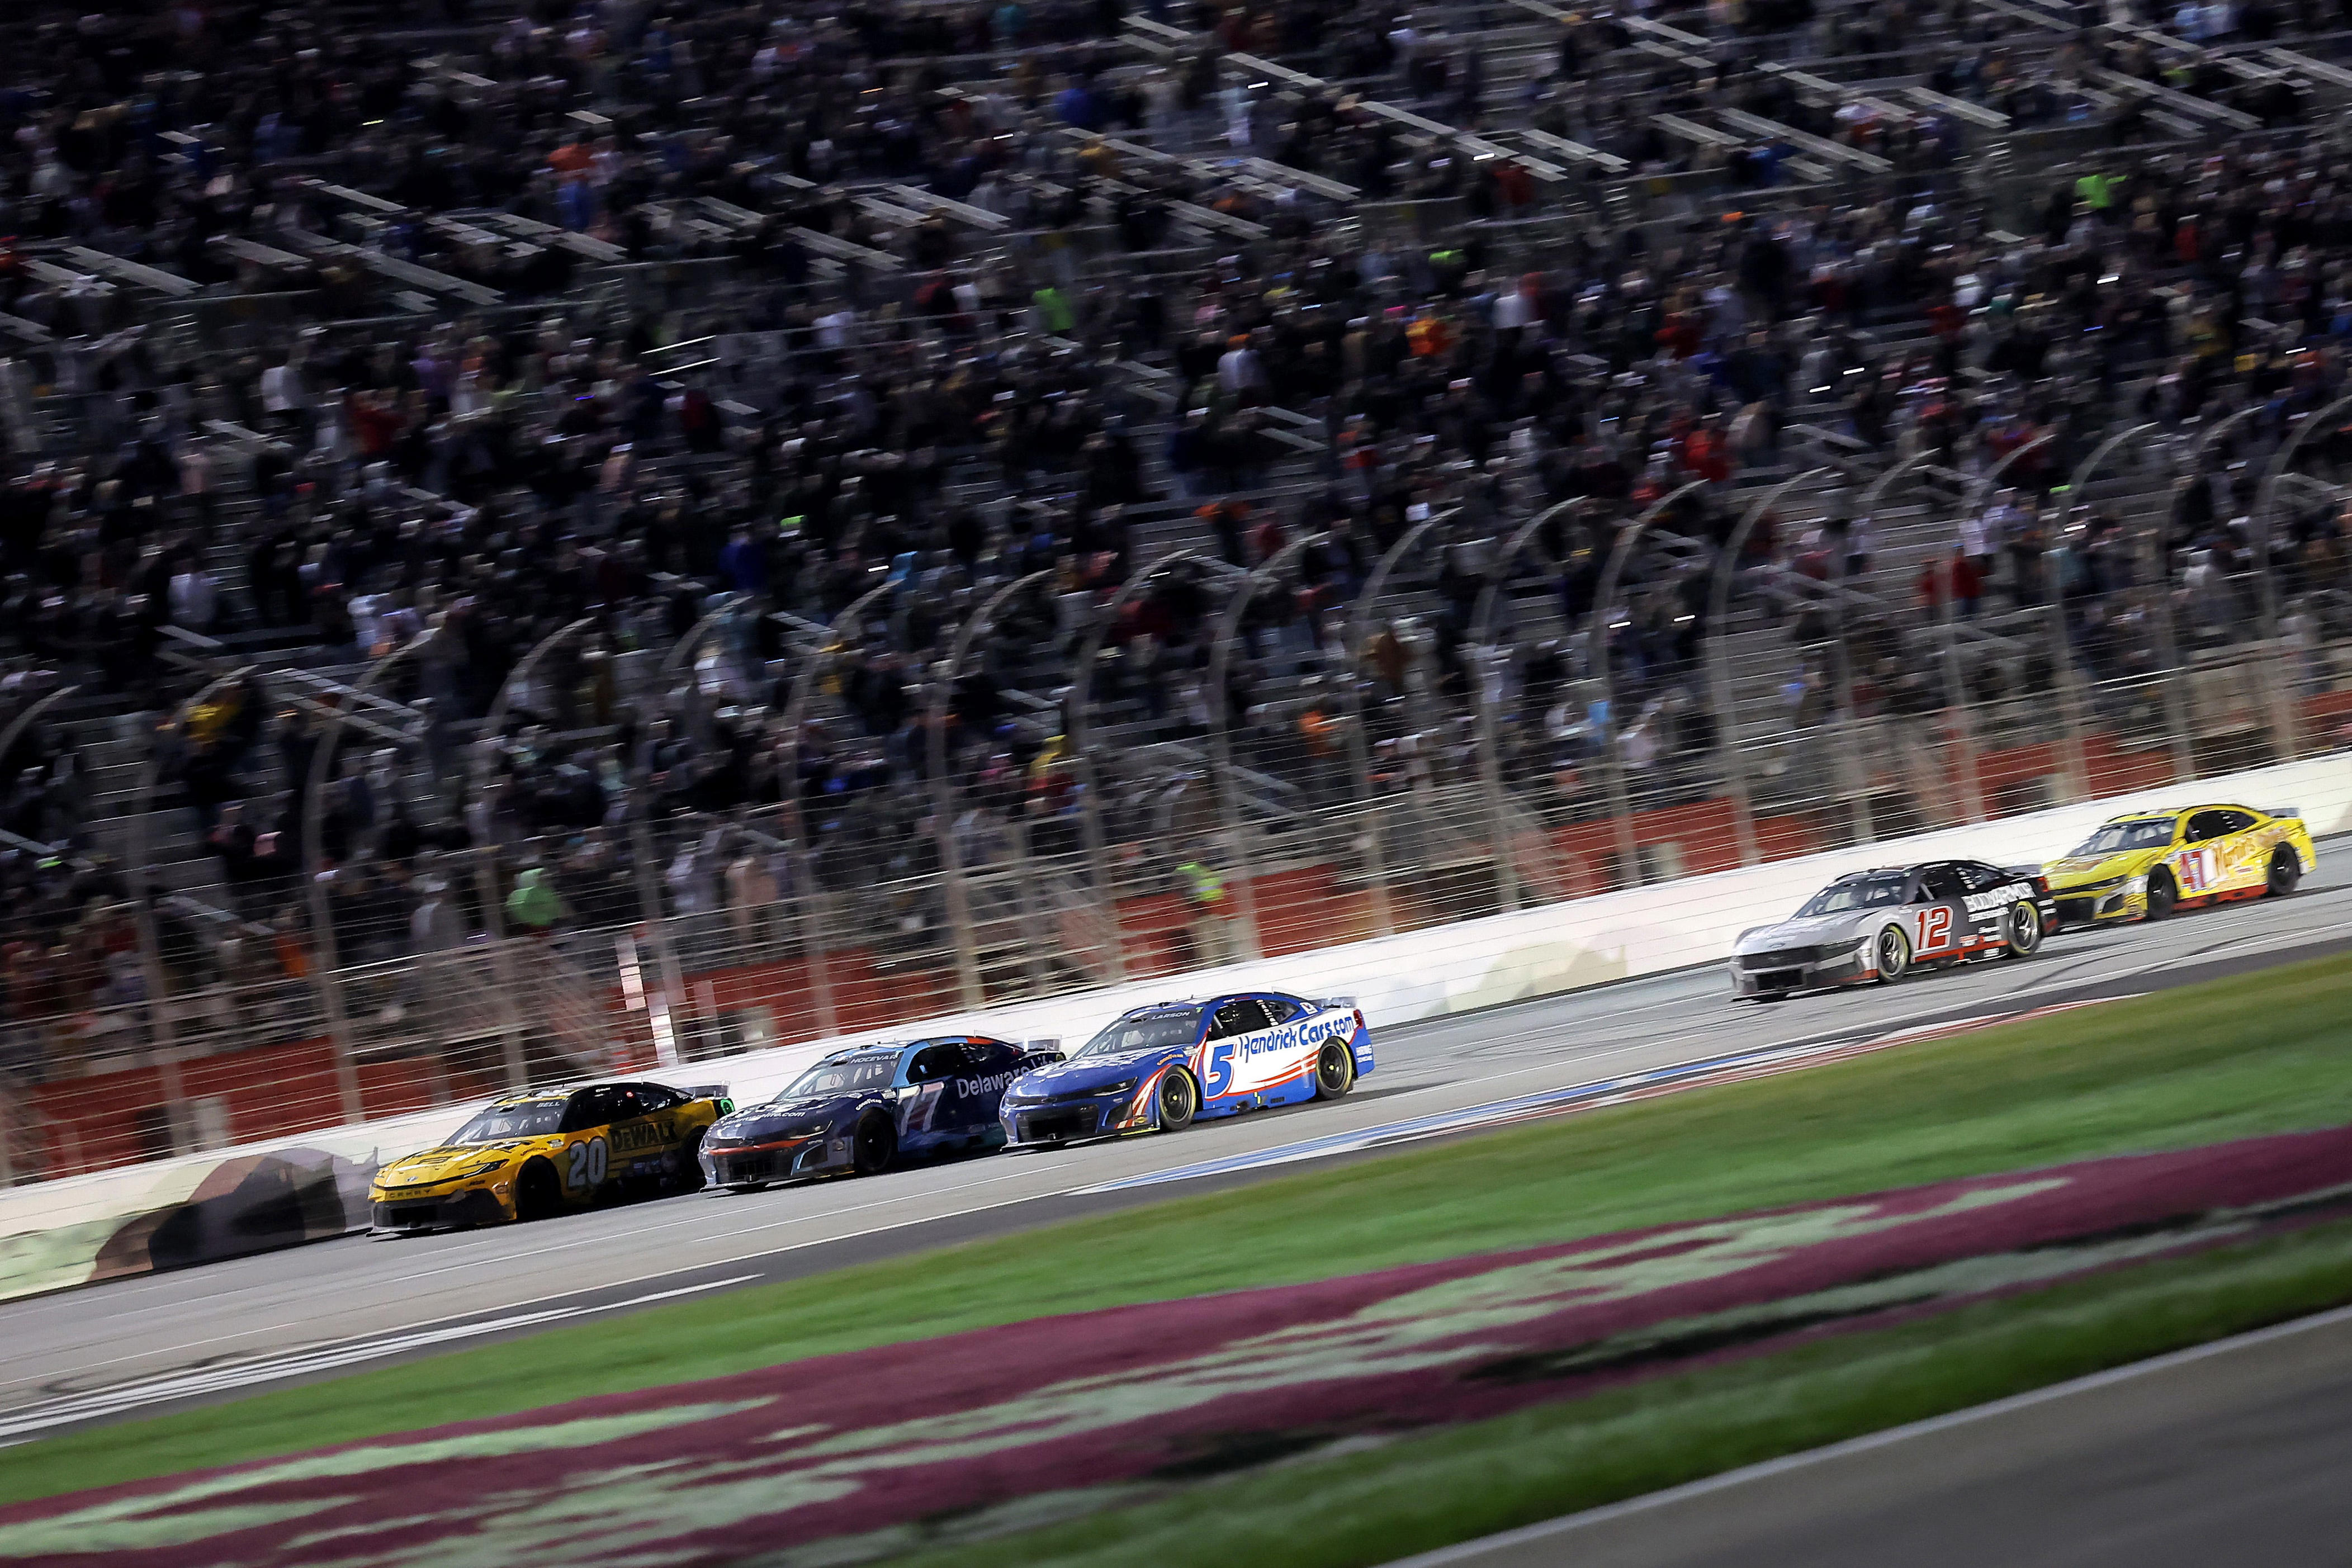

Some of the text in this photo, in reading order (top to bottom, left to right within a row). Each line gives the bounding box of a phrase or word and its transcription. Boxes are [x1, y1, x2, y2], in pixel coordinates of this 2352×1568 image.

[1914, 905, 1954, 954] 12
[1151, 1011, 1191, 1020] LARSON
[850, 1054, 897, 1064] HOCEVAR
[1204, 1043, 1238, 1102] 5
[897, 1079, 945, 1137] 77
[567, 1136, 608, 1188] 20
